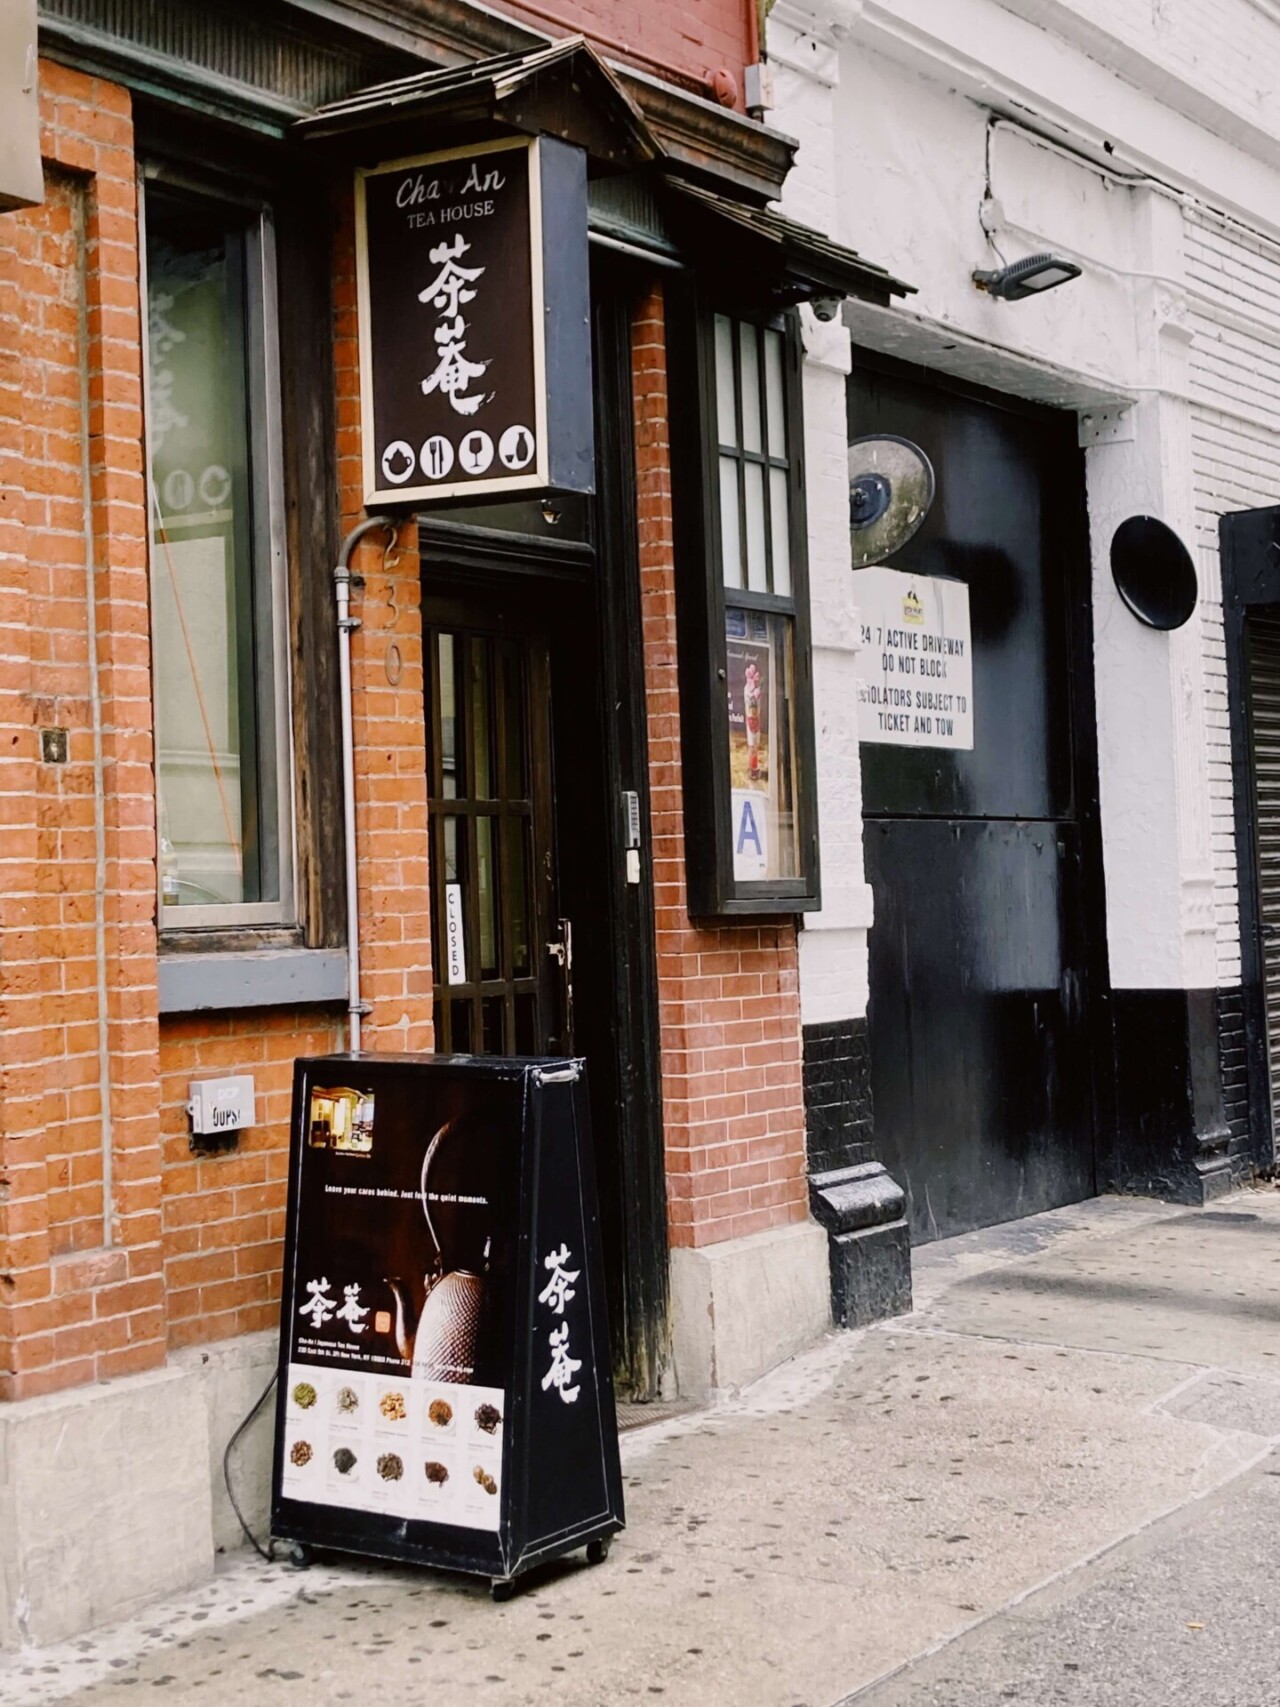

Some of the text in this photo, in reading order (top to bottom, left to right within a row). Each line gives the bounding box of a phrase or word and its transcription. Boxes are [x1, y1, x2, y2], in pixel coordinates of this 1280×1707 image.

[396, 163, 506, 208] Cha An
[407, 200, 494, 229] TEA HOUSE
[887, 629, 918, 651] ACTIVE
[922, 634, 964, 657] DRIVEWAY
[882, 653, 947, 679] DO NOT BLOCK
[916, 691, 953, 712] SUBJECT
[956, 696, 967, 714] TO
[878, 712, 954, 736] TICKET AND TOW
[737, 801, 762, 855] A
[448, 893, 459, 976] CLOSED
[325, 1184, 342, 1193] Leave
[343, 1187, 357, 1195] your
[401, 1190, 413, 1199] Just
[428, 1192, 439, 1201] the
[440, 1194, 456, 1203] quiet
